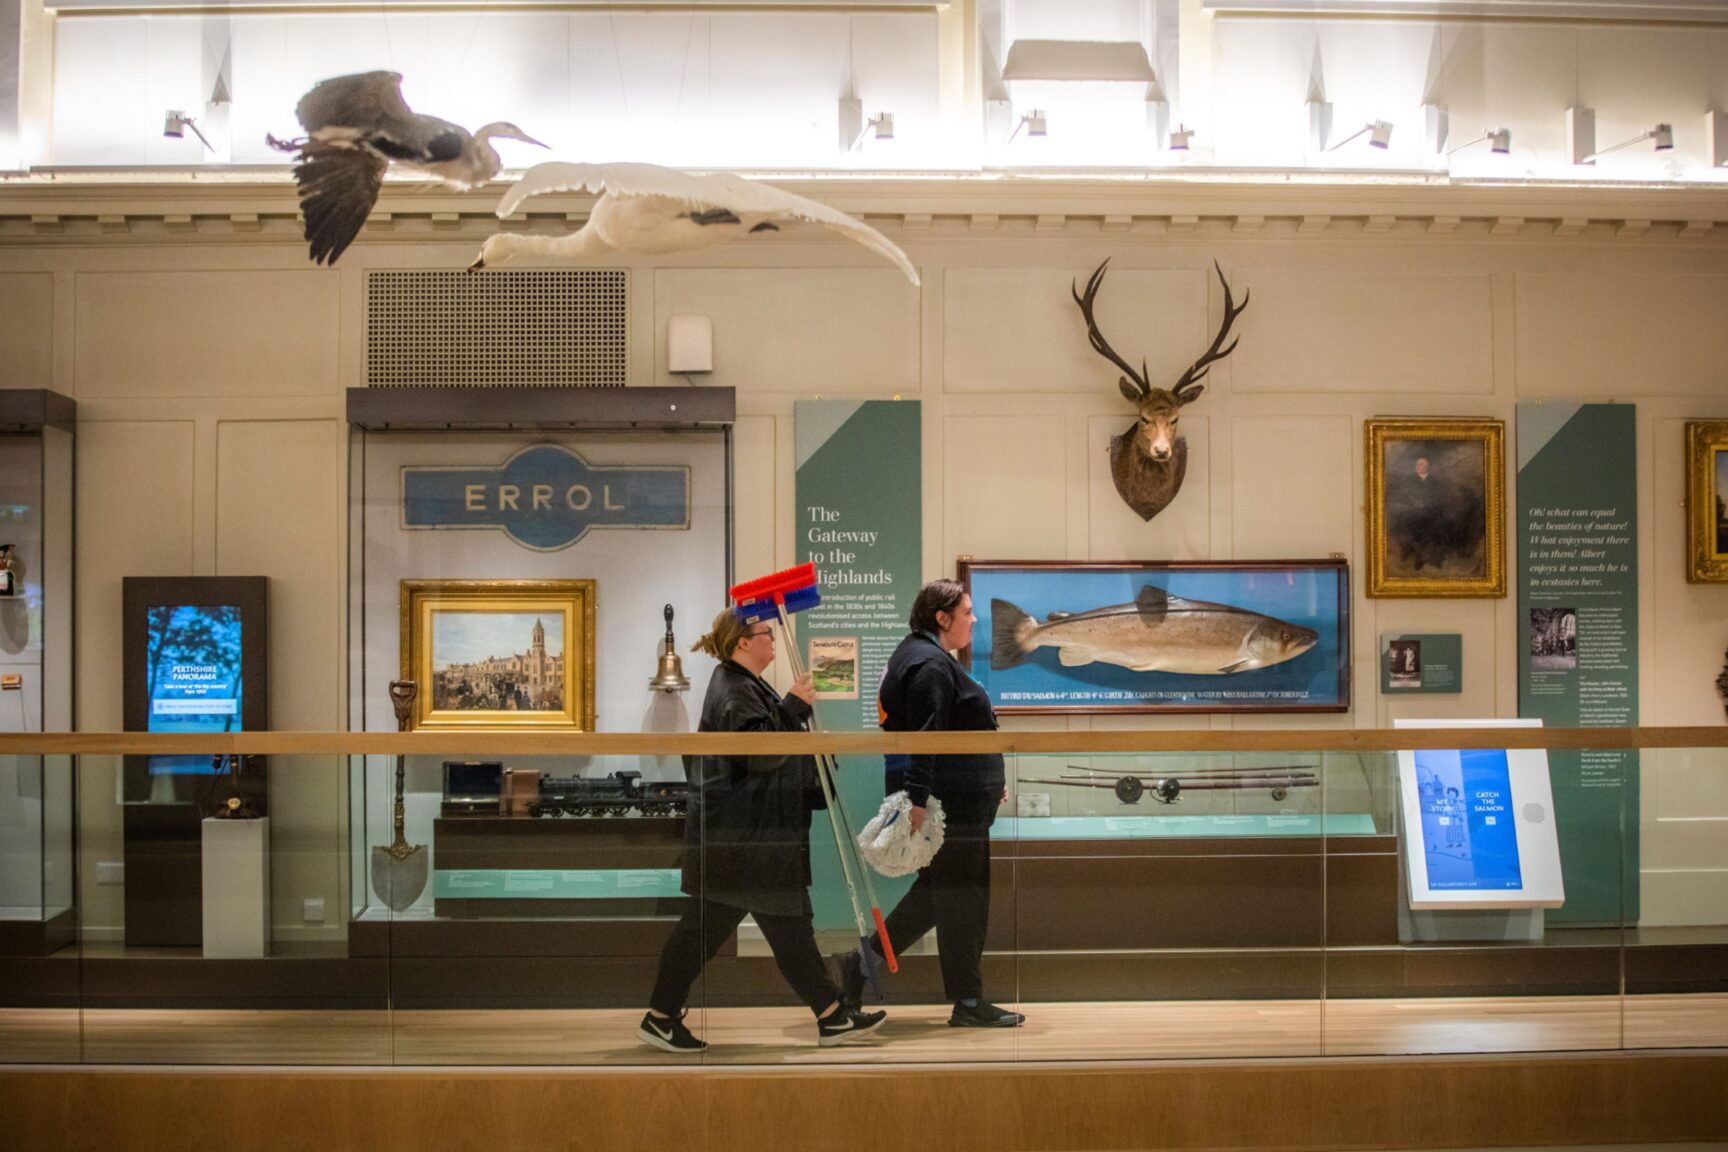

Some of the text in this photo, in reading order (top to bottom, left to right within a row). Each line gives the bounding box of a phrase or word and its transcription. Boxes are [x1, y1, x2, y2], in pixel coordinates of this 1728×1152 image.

[465, 484, 626, 511] ERROL
[808, 506, 840, 522] The
[1529, 507, 1546, 517] Oh!
[1546, 508, 1570, 517] what
[1590, 508, 1616, 519] equal
[1530, 521, 1628, 533] the beauties of nature!
[808, 528, 878, 546] Gateway
[1530, 536, 1630, 547] What enjoyment there
[808, 548, 856, 564] to the
[1530, 549, 1605, 558] is in them! Albert
[1530, 564, 1558, 574] enjoys
[1560, 564, 1567, 572] it
[1580, 564, 1605, 572] much
[1607, 564, 1617, 572] he
[1620, 564, 1628, 572] is
[1530, 578, 1603, 586] in ecstasies here.
[865, 593, 884, 602] public
[808, 621, 839, 629] Scotland's
